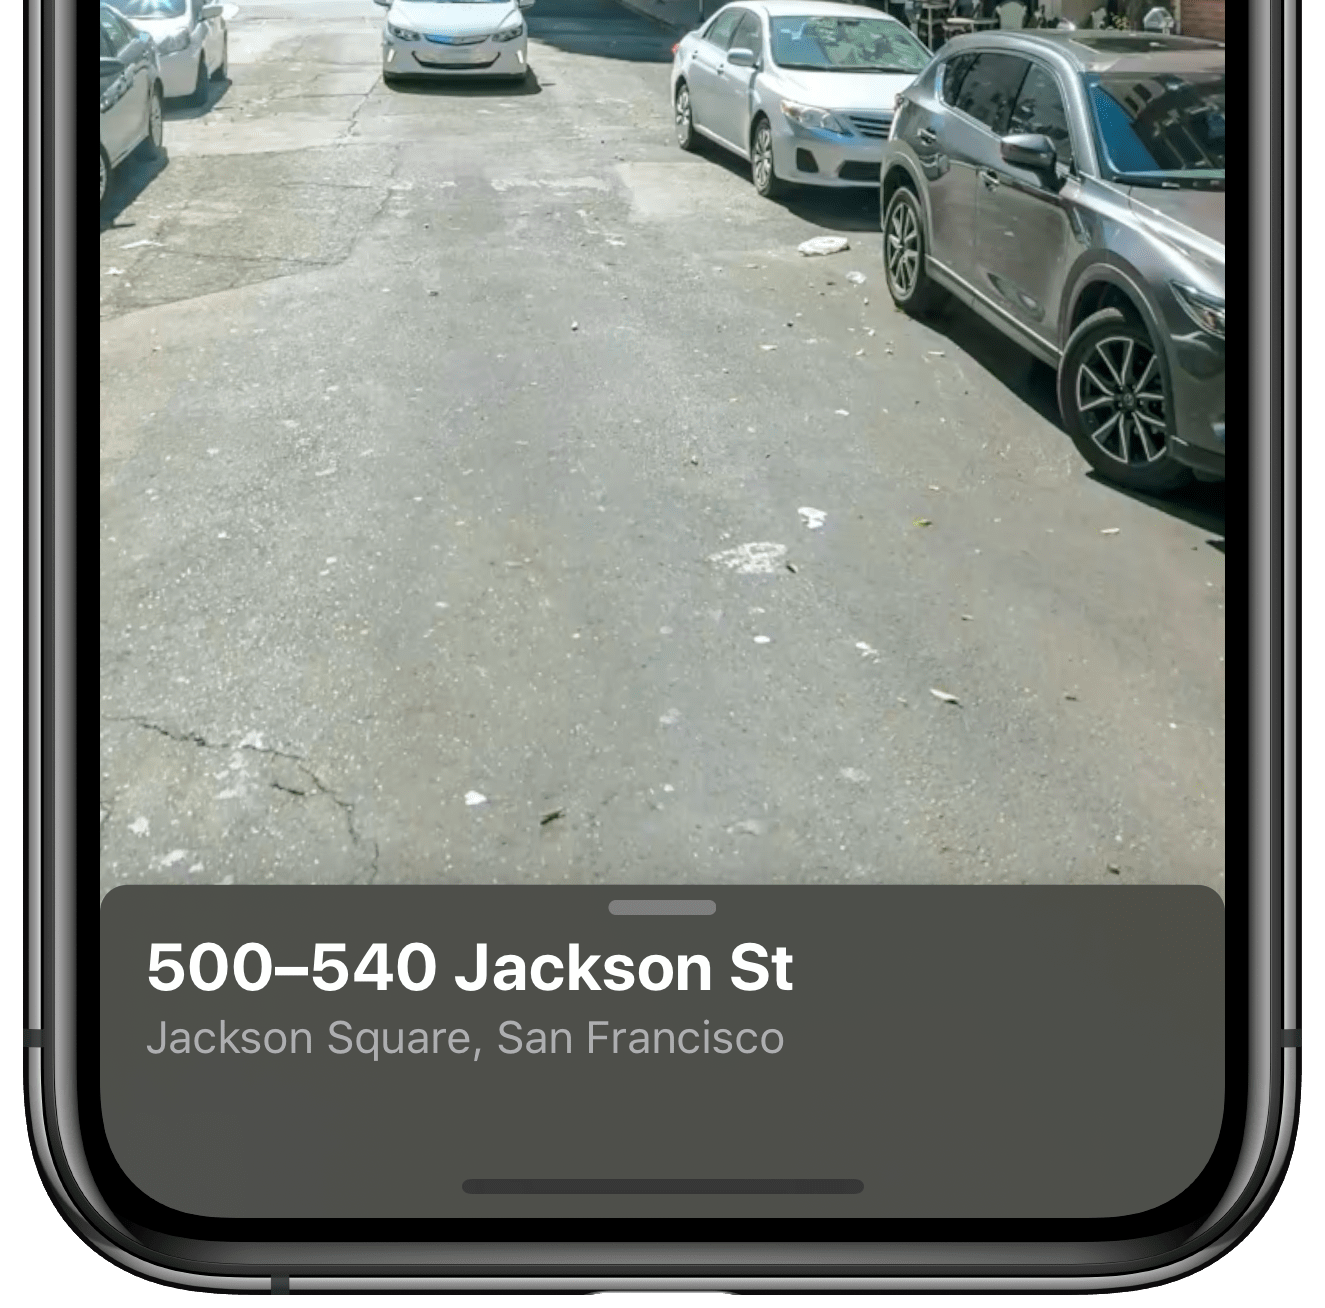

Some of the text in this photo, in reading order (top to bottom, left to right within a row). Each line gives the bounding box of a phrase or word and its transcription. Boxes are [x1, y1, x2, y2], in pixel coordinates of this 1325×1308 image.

[455, 942, 711, 992] Jackson
[730, 942, 793, 992] St
[146, 1019, 784, 1062] Jackson Square, San Francisco
